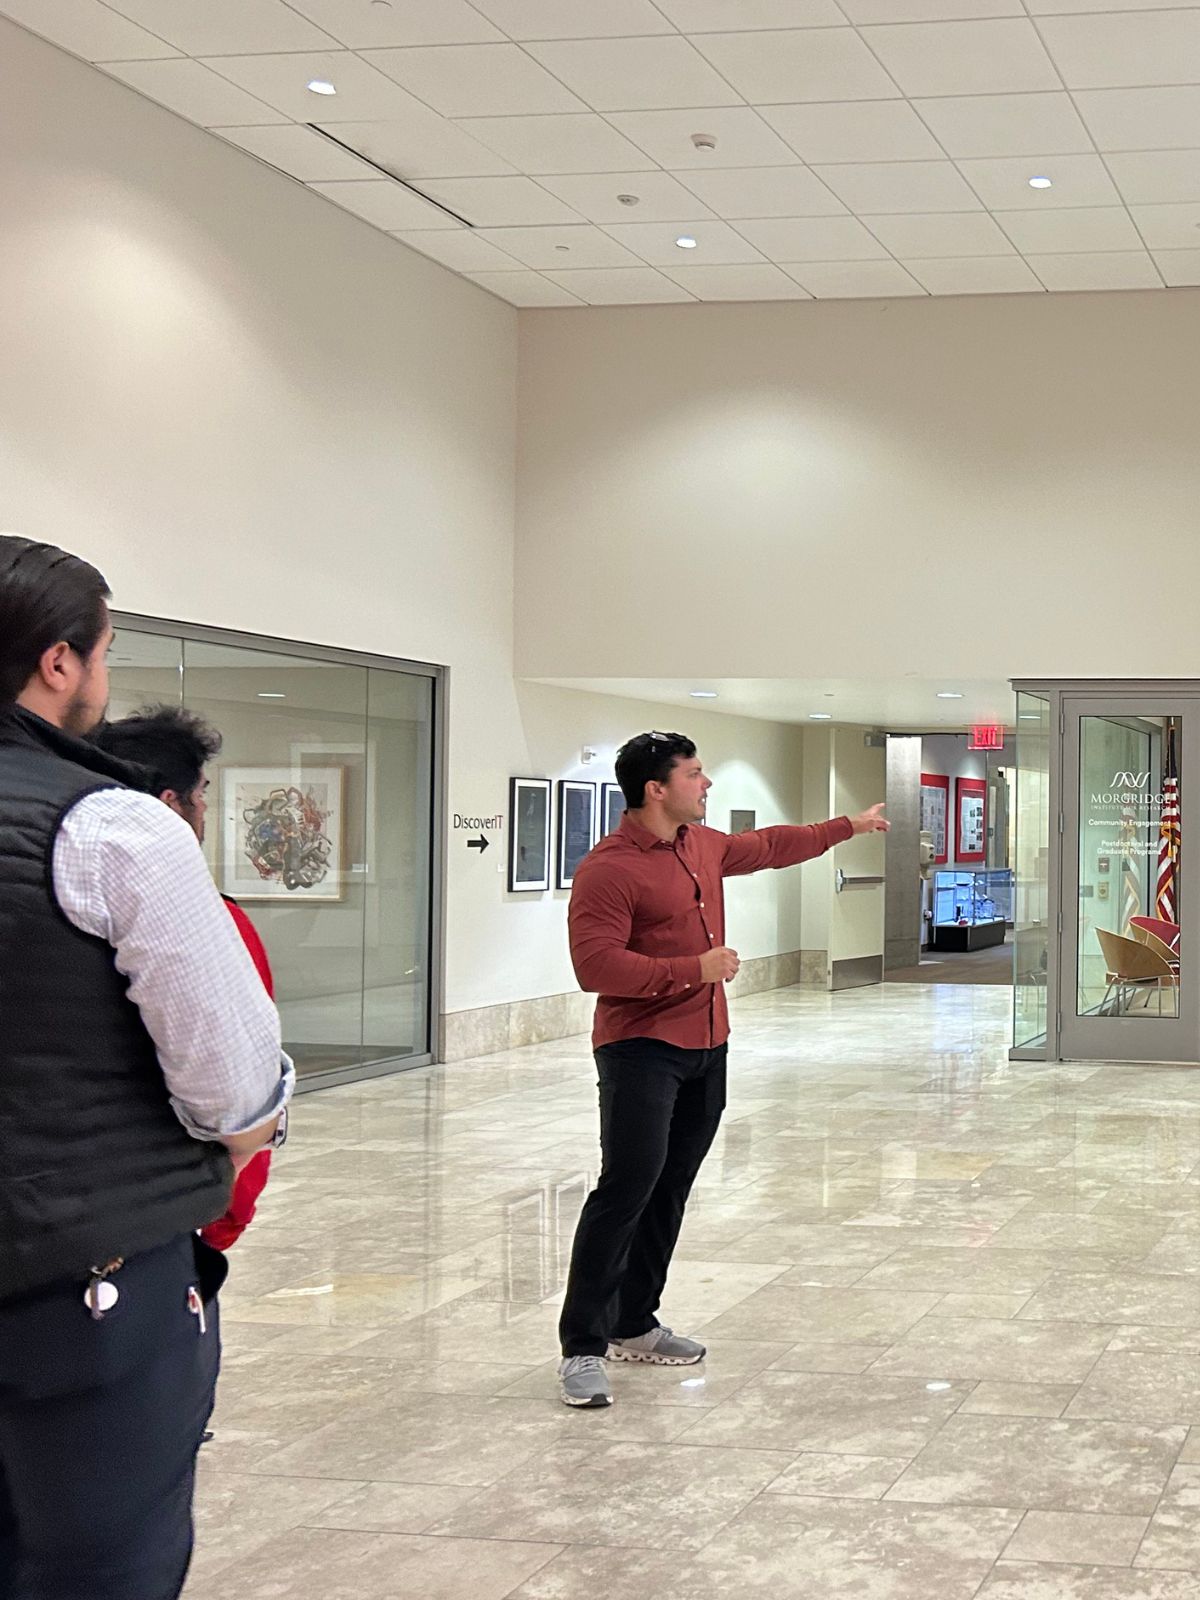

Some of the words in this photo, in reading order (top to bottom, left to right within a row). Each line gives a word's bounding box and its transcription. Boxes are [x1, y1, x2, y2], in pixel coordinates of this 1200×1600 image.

[974, 725, 997, 746] EXIT
[1090, 793, 1171, 804] MORGRIDGE
[453, 814, 504, 829] DiscoverIT
[1088, 819, 1128, 827] Community
[1129, 819, 1171, 828] Engagement
[1129, 848, 1162, 856] Programs
